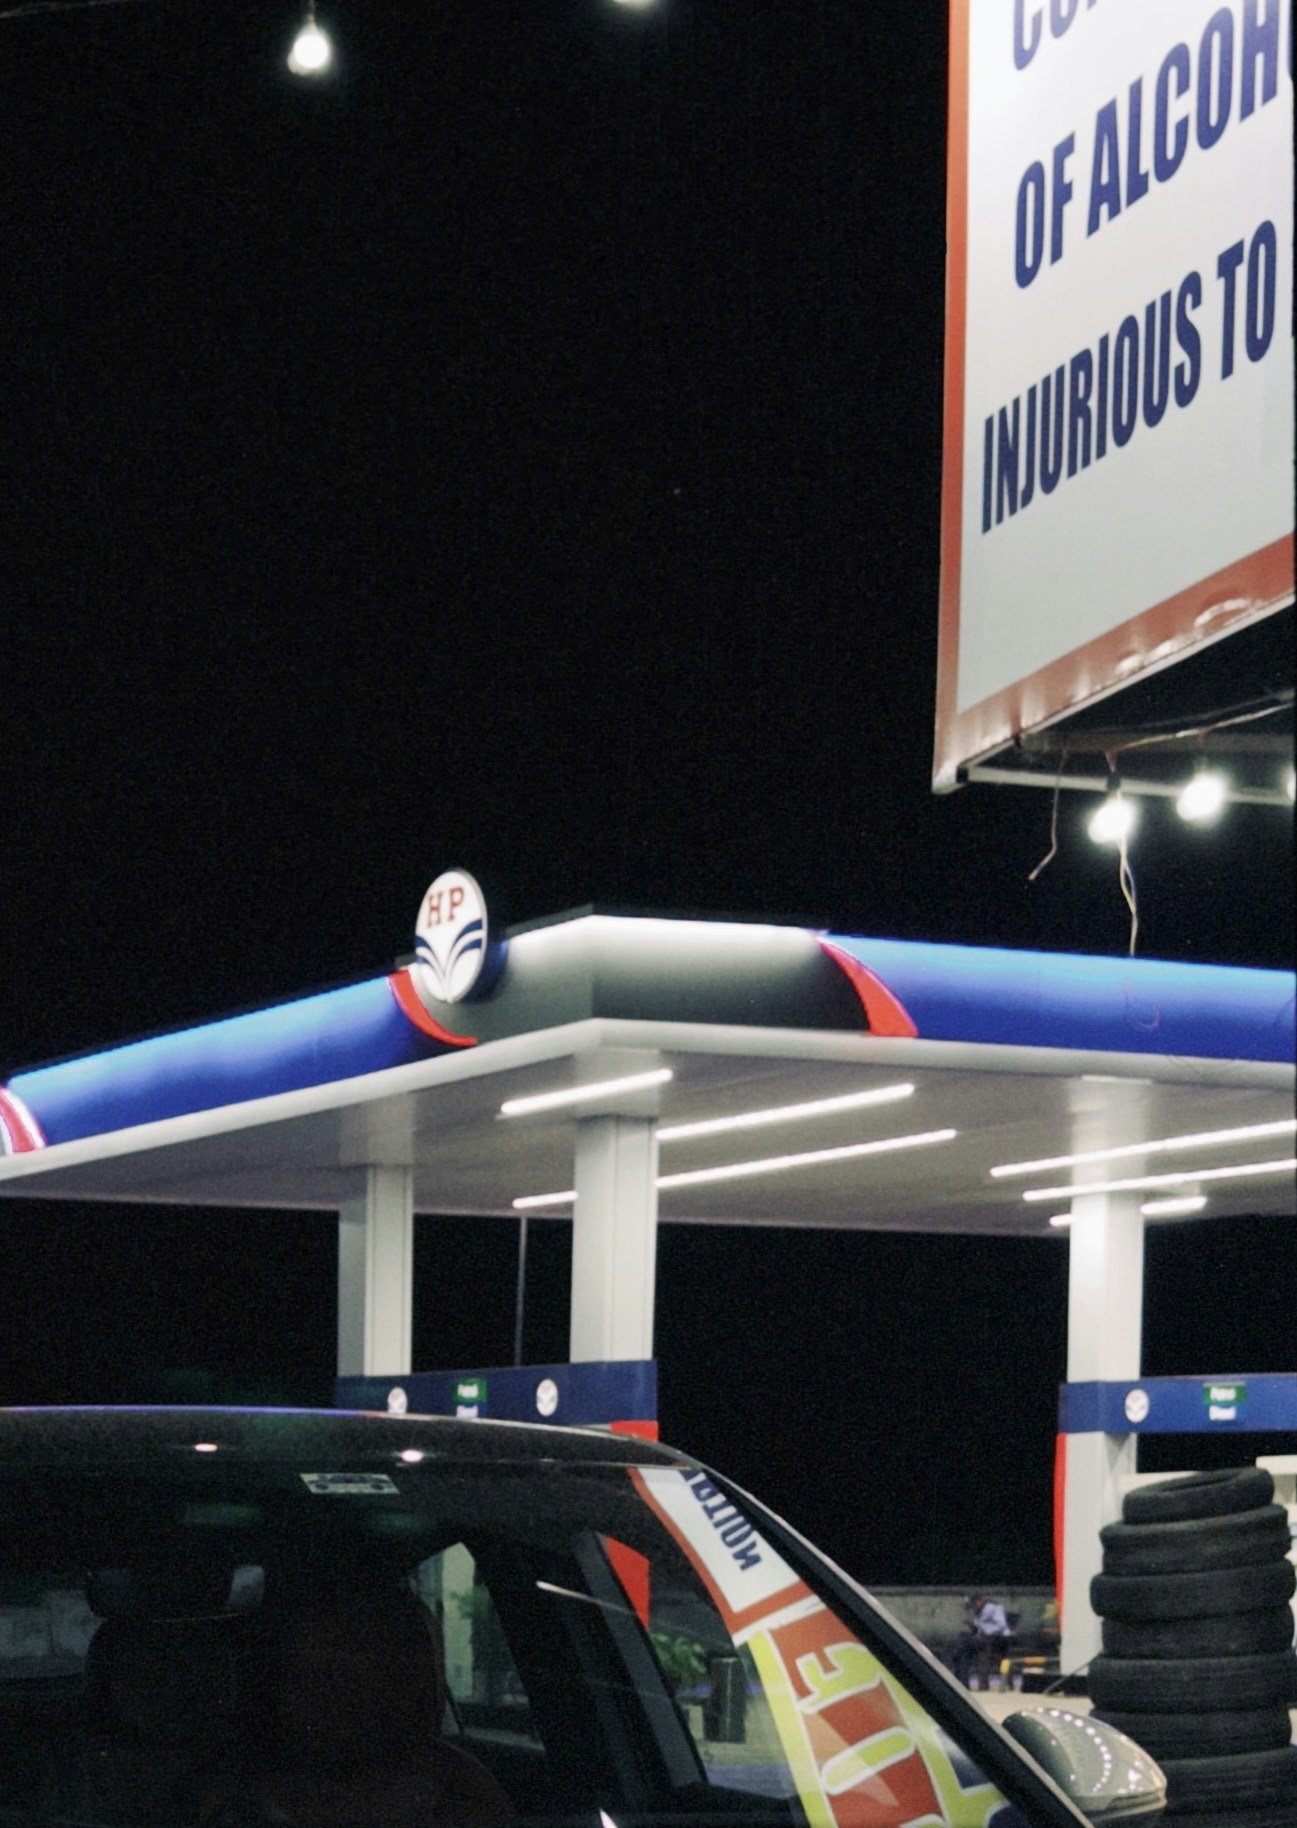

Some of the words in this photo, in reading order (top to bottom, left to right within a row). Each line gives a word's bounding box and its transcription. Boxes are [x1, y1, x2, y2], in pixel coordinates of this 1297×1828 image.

[1014, 131, 1075, 289] OF
[1086, 0, 1295, 238] ALCOH
[982, 271, 1202, 535] INJURIOUS
[1217, 220, 1277, 381] TO
[427, 886, 465, 929] HP
